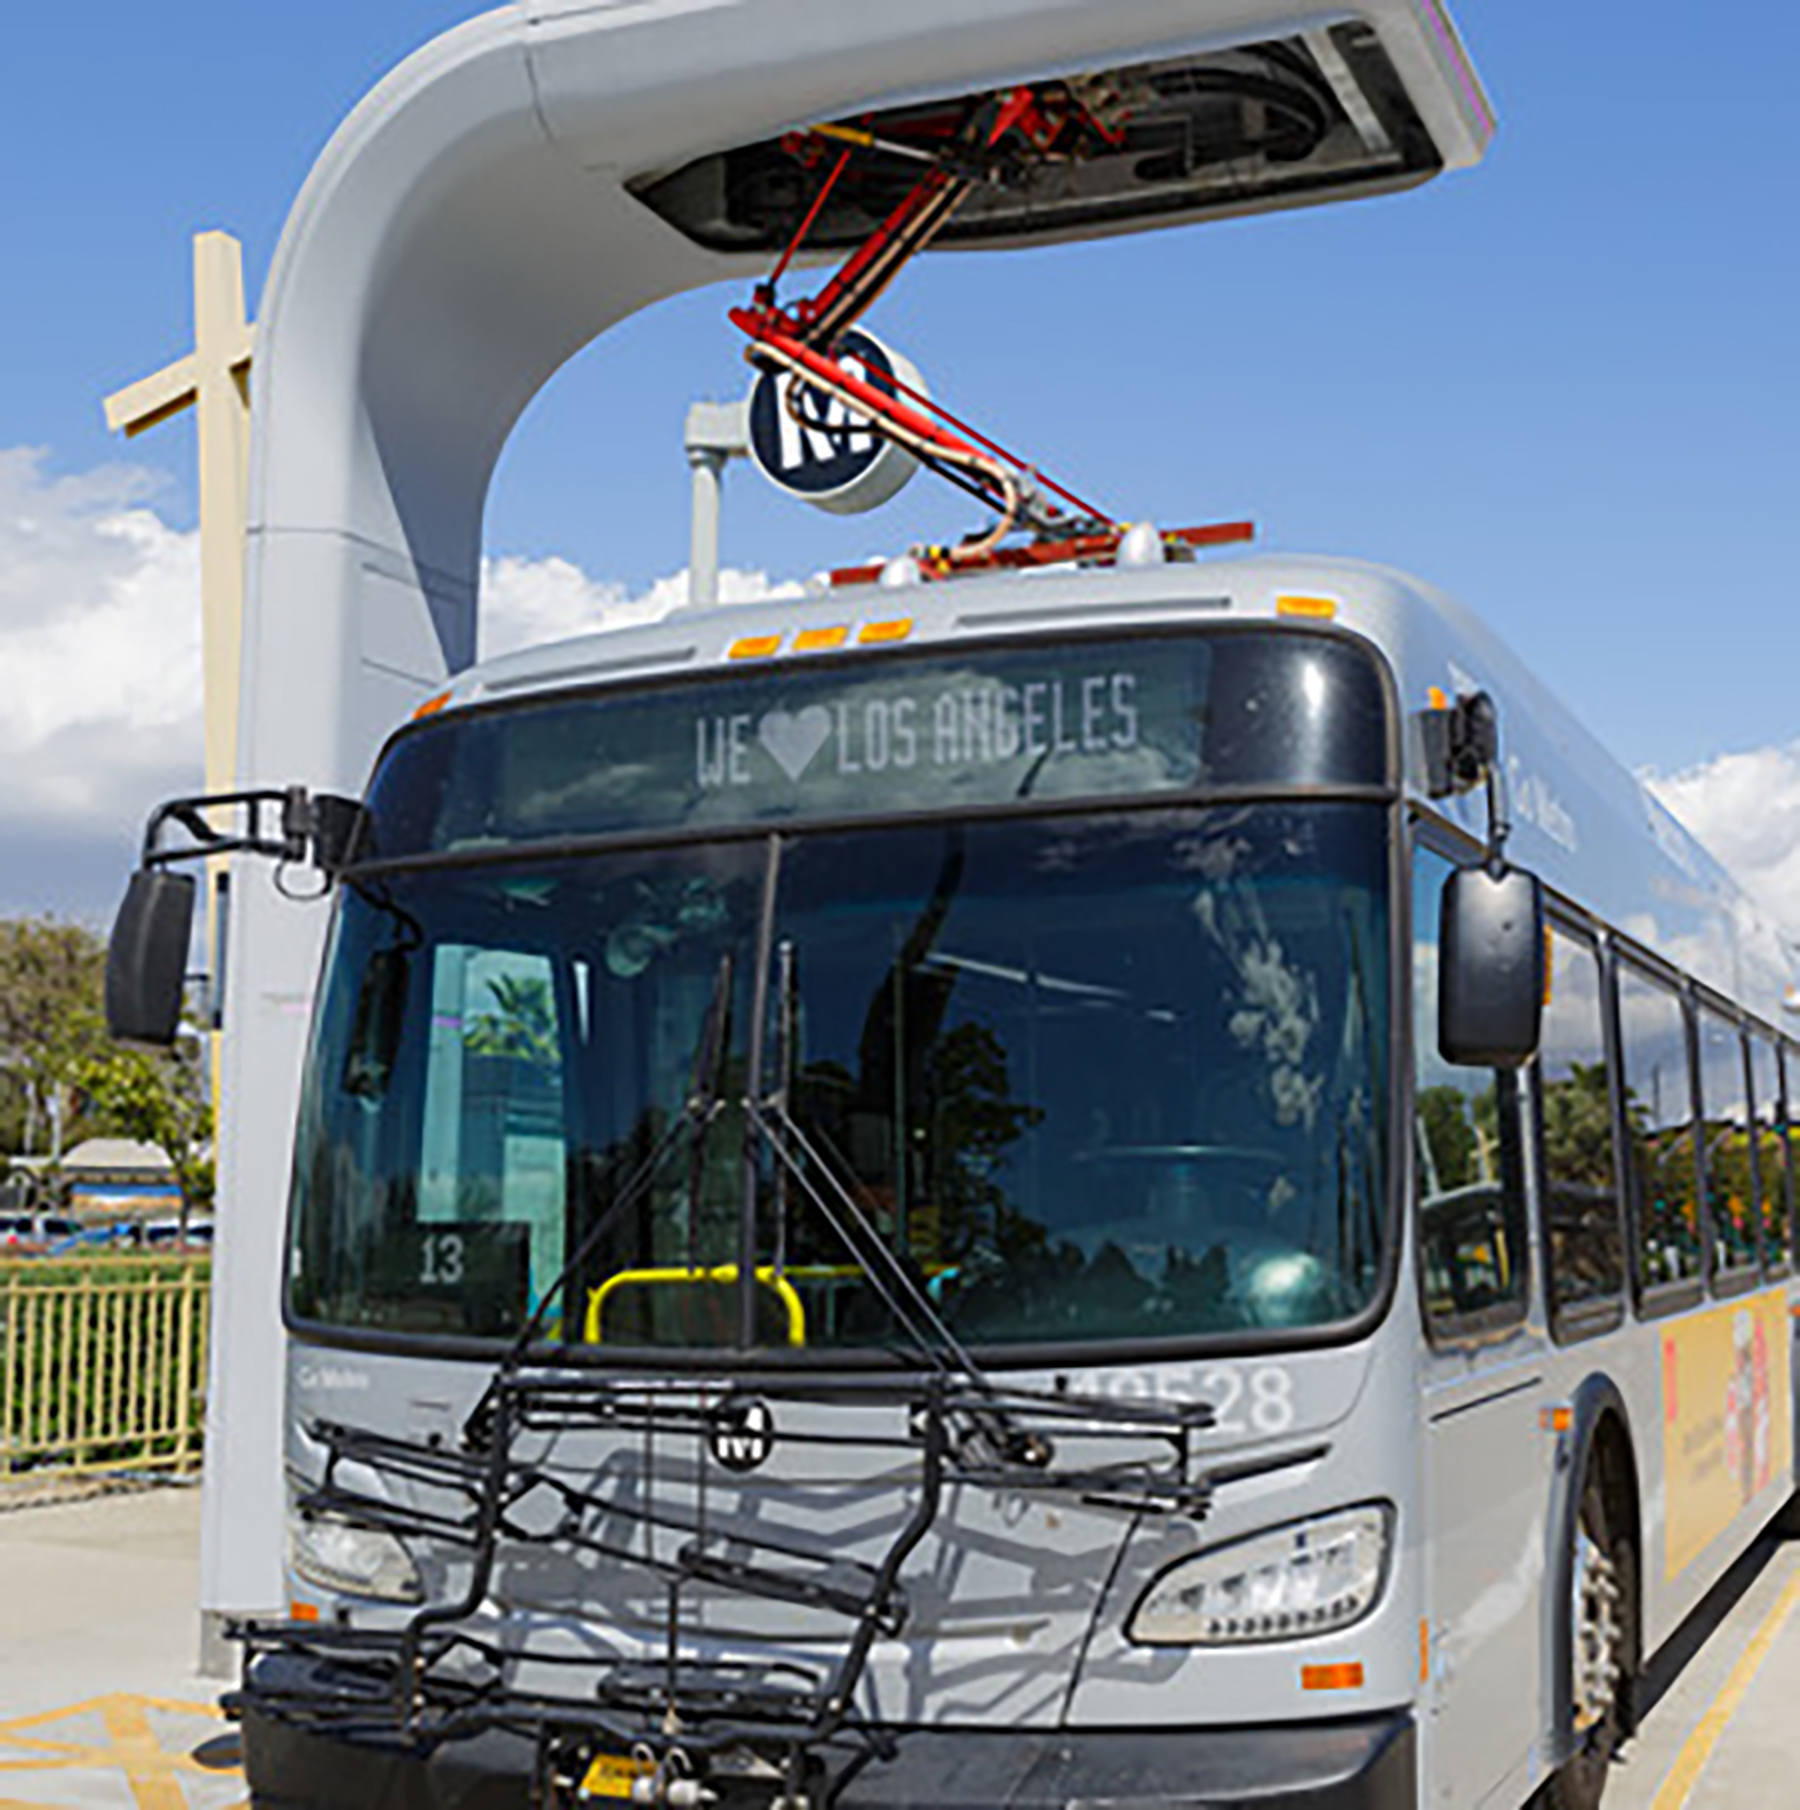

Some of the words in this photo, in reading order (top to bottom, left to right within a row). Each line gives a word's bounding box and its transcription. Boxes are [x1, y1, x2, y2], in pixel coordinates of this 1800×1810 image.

[696, 714, 750, 786] WE
[837, 700, 917, 774] LOS
[933, 674, 1137, 765] ANGELES
[419, 1234, 464, 1284] 13
